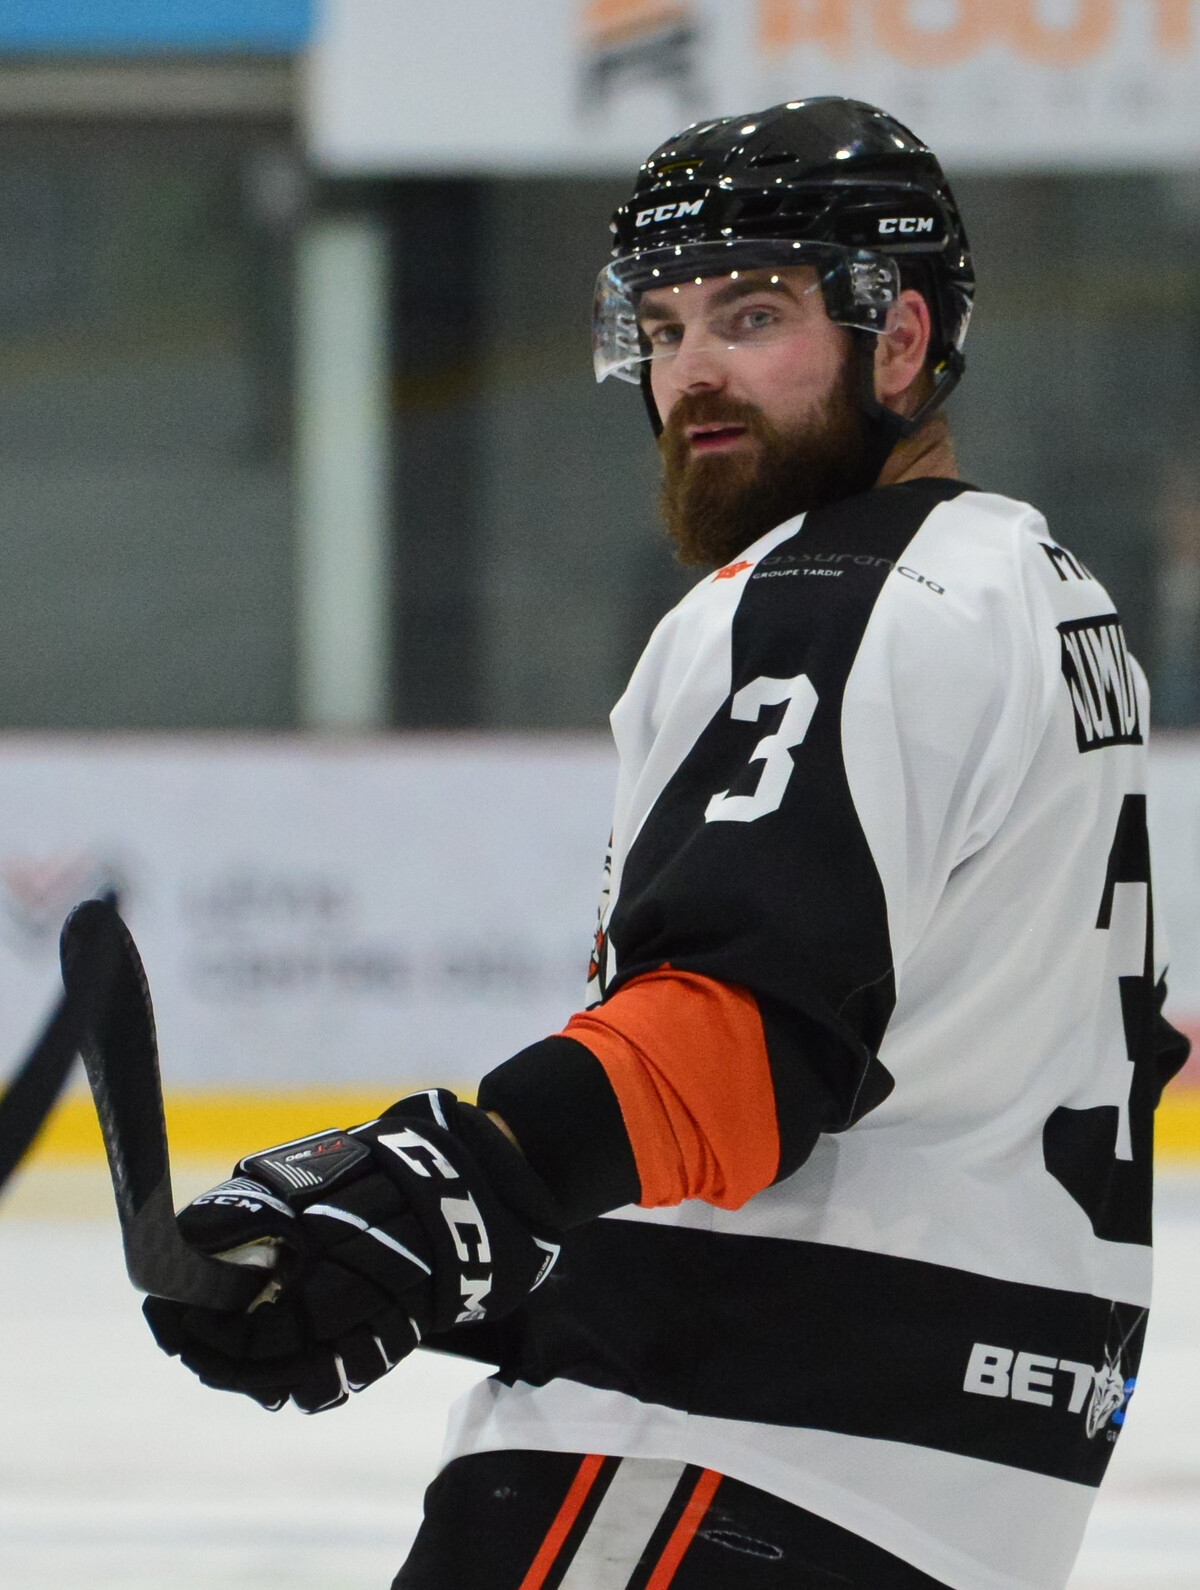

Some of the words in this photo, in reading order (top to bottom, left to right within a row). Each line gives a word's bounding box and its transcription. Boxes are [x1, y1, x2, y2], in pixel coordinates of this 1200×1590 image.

[636, 199, 704, 228] CCM
[878, 217, 934, 234] CCM
[752, 569, 800, 580] GROUPE
[802, 568, 845, 578] TARDIF
[761, 552, 945, 596] assurancia
[705, 674, 818, 823] 3
[192, 1195, 263, 1213] CCM
[377, 1126, 493, 1324] CCM
